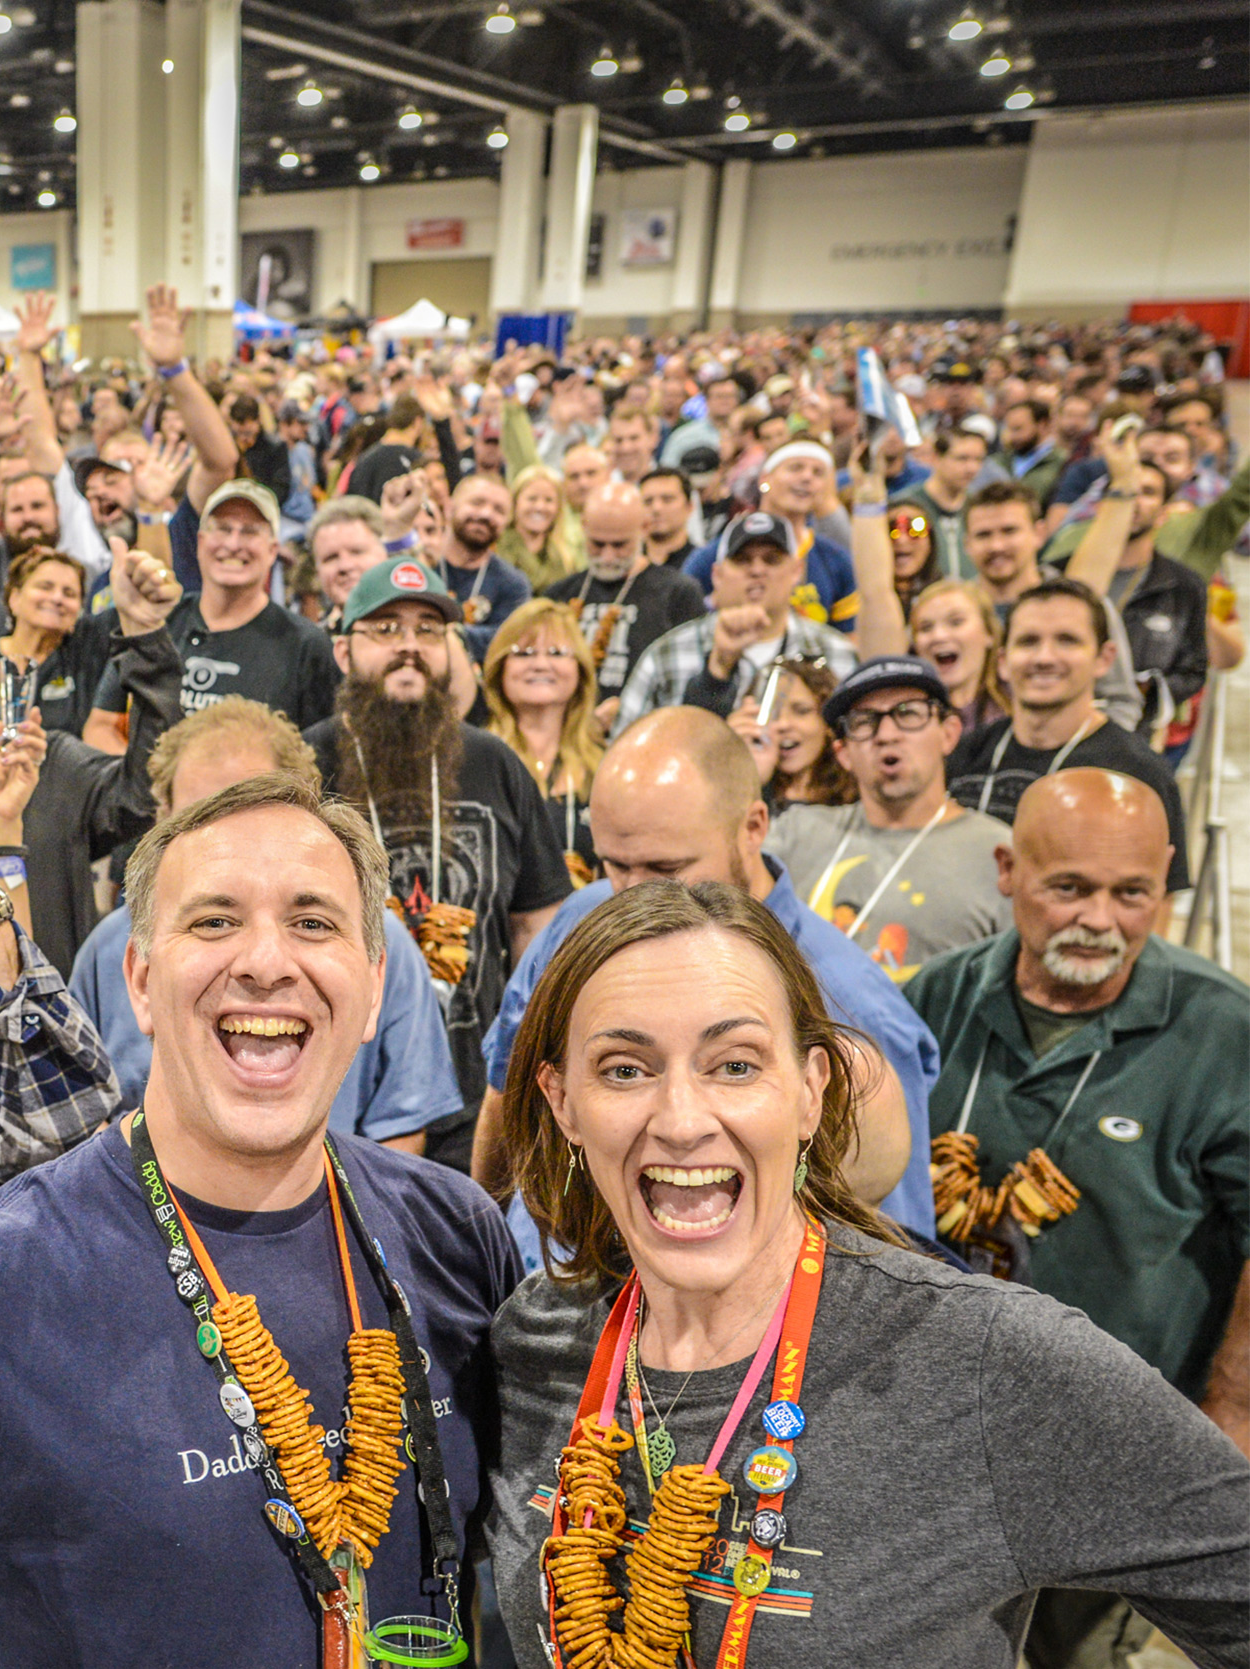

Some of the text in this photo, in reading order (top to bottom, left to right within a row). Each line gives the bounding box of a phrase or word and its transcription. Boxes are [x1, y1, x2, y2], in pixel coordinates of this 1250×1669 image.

[142, 1160, 167, 1206] Caddy
[178, 1272, 199, 1296] CSB
[777, 1348, 801, 1401] MANN
[431, 1397, 453, 1418] er
[774, 1403, 795, 1432] LOCAL
[781, 1401, 802, 1428] SUPPORT
[767, 1408, 789, 1437] BEER
[753, 1464, 783, 1477] BEER
[703, 1555, 725, 1574] 12
